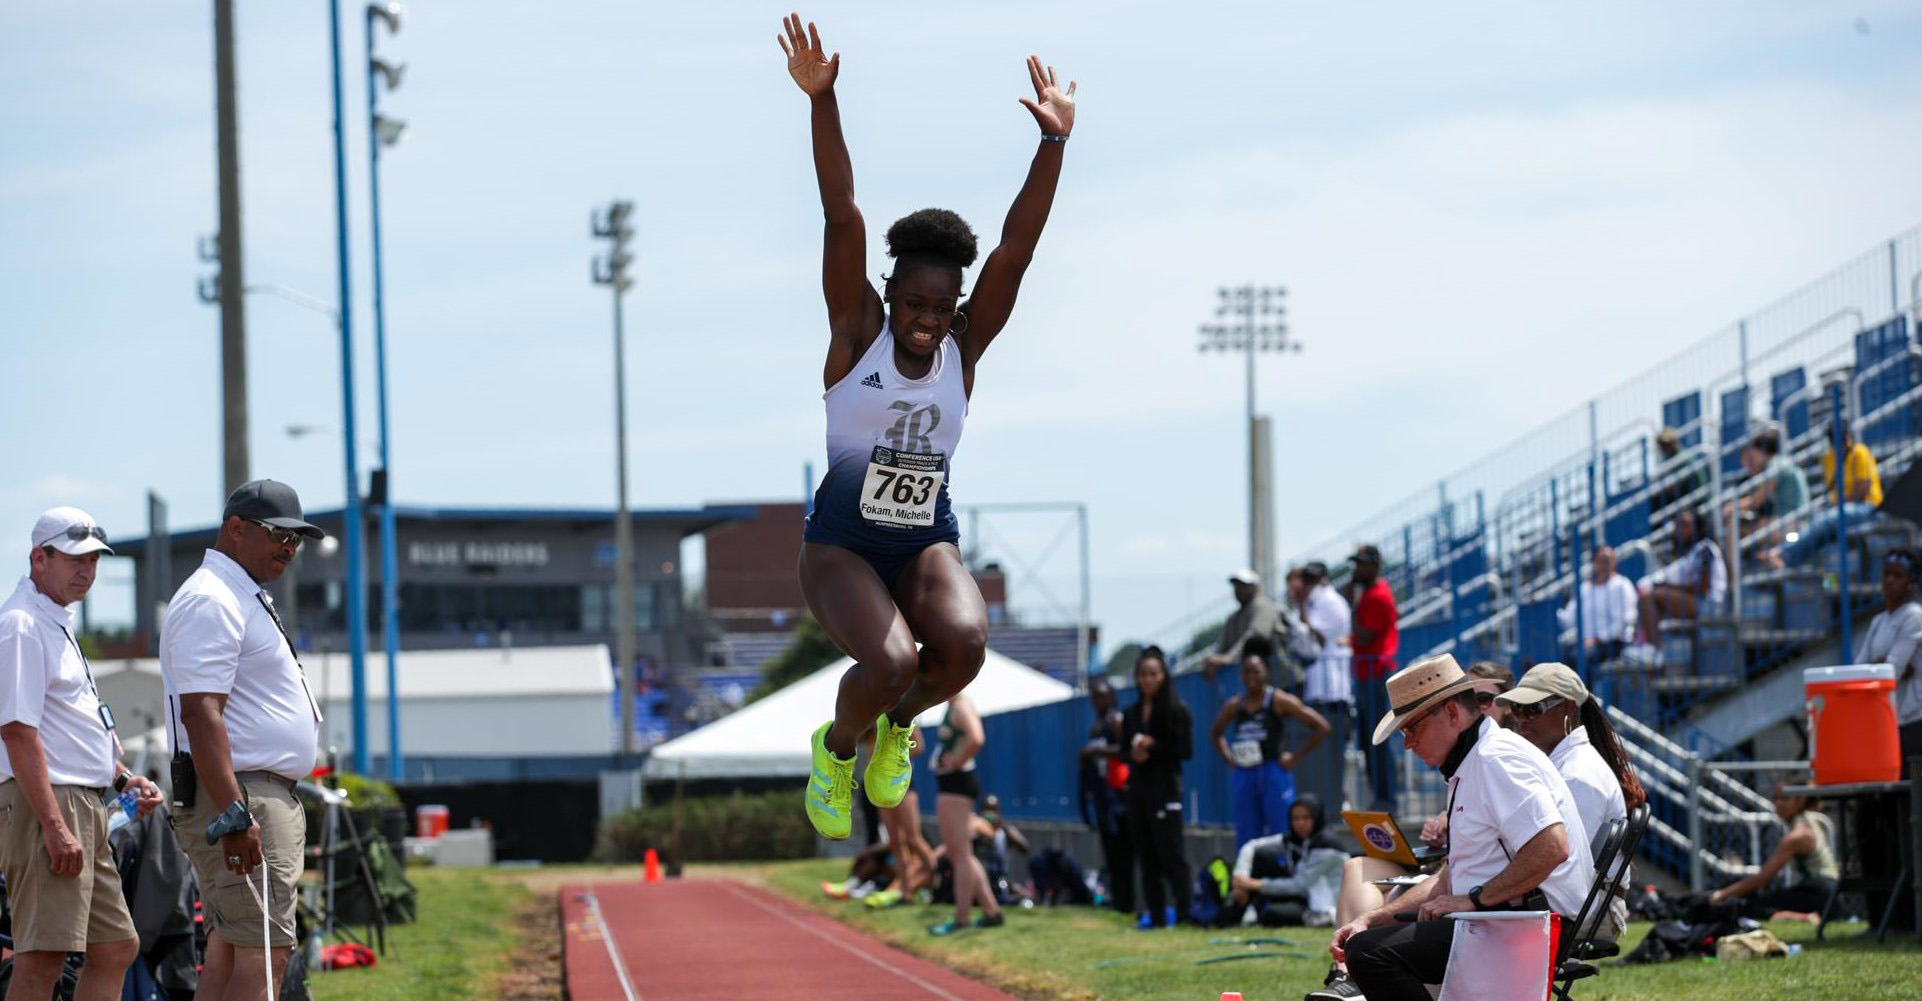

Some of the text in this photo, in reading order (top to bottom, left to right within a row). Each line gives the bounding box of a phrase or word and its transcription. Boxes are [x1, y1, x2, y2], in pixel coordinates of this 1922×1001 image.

[861, 380, 883, 389] adidas
[895, 453, 933, 461] CONFERENCE
[873, 469, 934, 506] 763
[861, 503, 931, 520] Fokam, Michelle
[408, 542, 549, 564] BLUE RAIDERS
